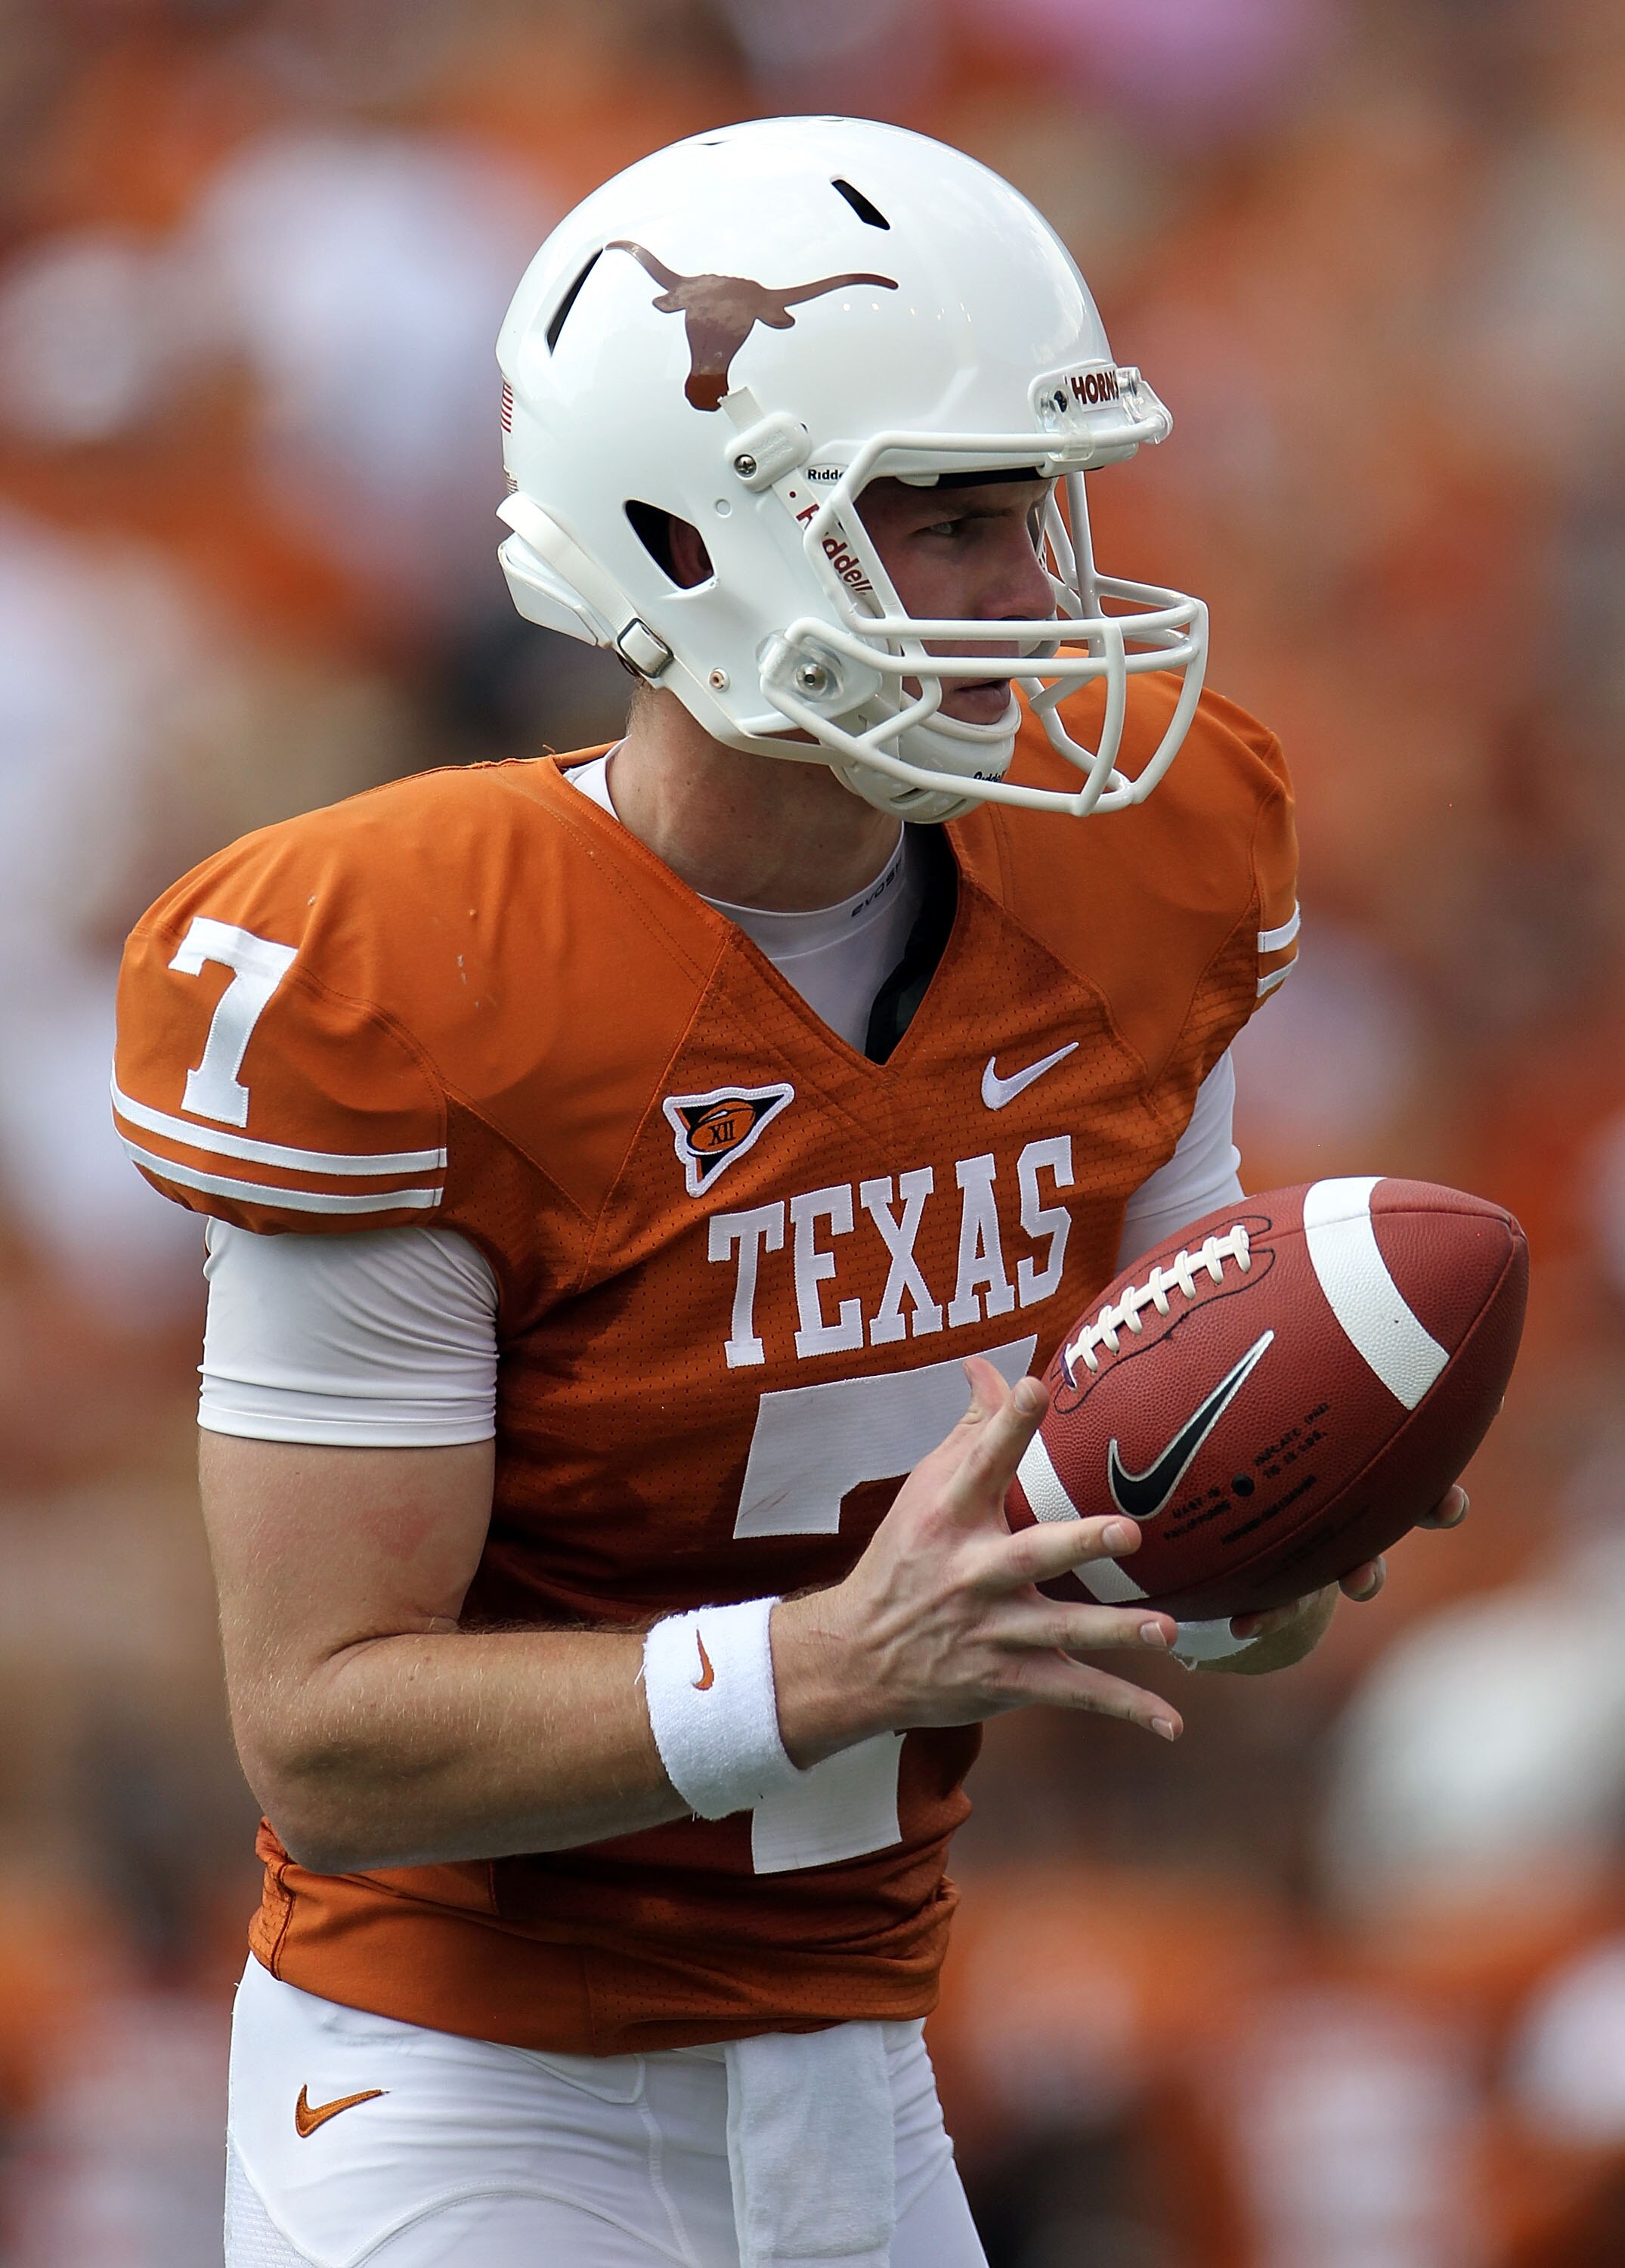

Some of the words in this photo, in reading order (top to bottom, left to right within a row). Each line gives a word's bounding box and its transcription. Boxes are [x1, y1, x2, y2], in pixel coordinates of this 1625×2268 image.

[168, 916, 299, 1129] 7
[707, 1119, 736, 1146] XII
[707, 1135, 1075, 1369] TEXAS
